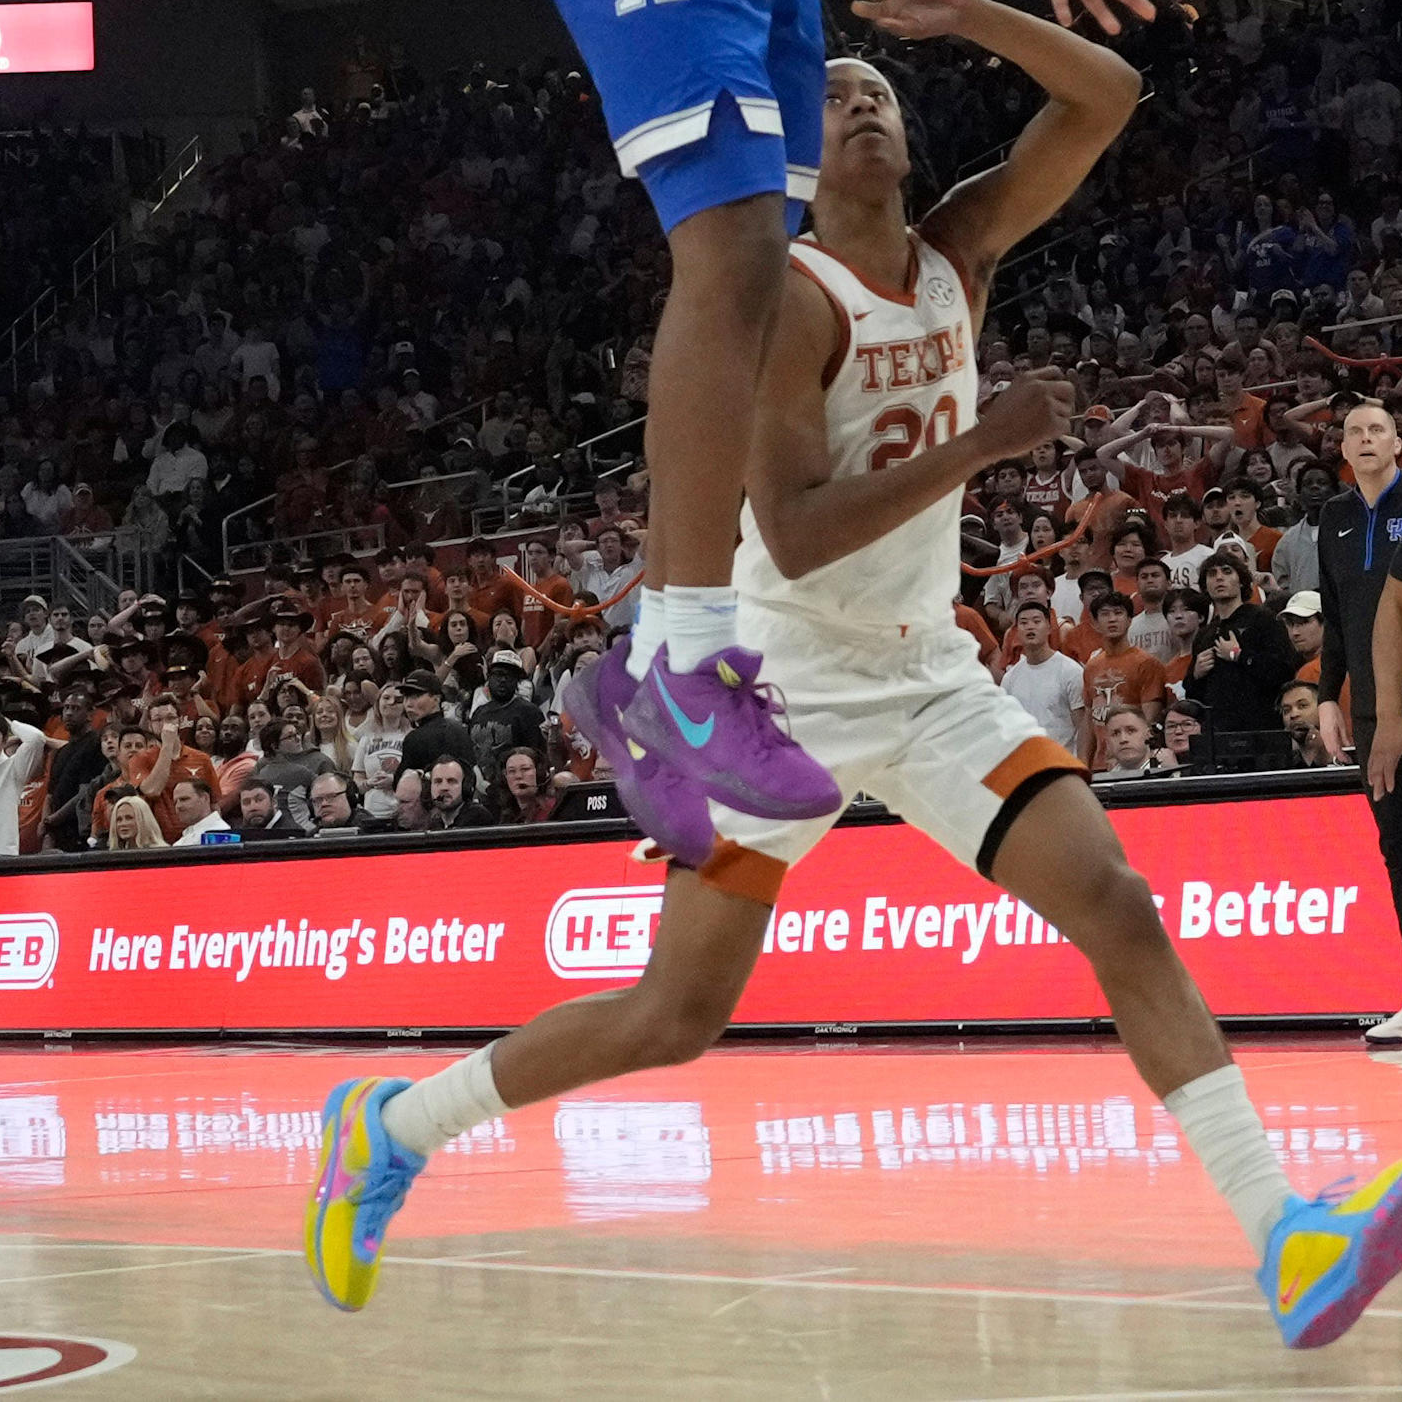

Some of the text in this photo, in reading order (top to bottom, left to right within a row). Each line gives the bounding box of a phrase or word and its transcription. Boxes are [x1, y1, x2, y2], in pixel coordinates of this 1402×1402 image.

[869, 392, 958, 471] 20
[586, 795, 608, 811] POSS
[1179, 879, 1358, 940] Better
[89, 926, 166, 973] Here
[169, 916, 374, 982] Everything's
[385, 915, 505, 965] Better
